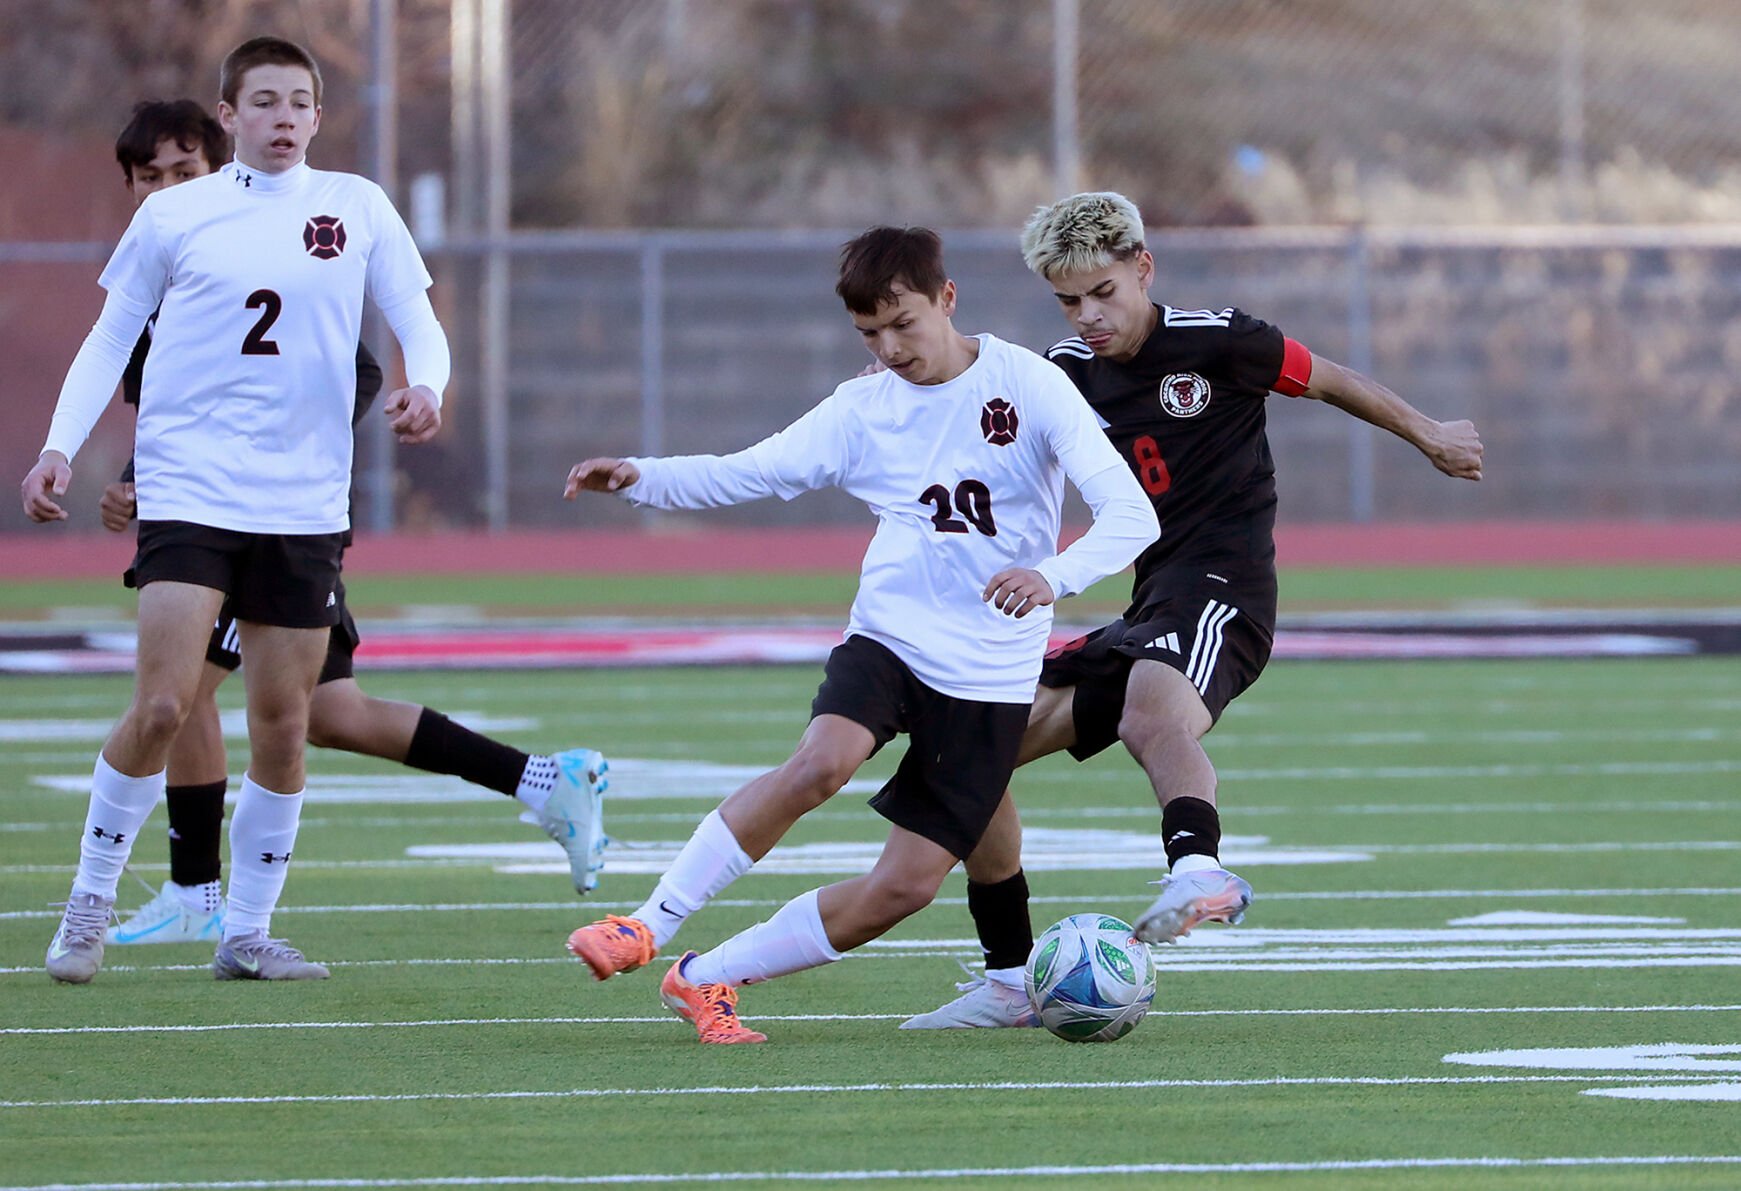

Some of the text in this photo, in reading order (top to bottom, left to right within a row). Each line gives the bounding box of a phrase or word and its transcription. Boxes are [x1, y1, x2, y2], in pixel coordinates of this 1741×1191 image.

[241, 288, 282, 355] 2
[1132, 434, 1172, 496] 8
[918, 478, 997, 537] 20
